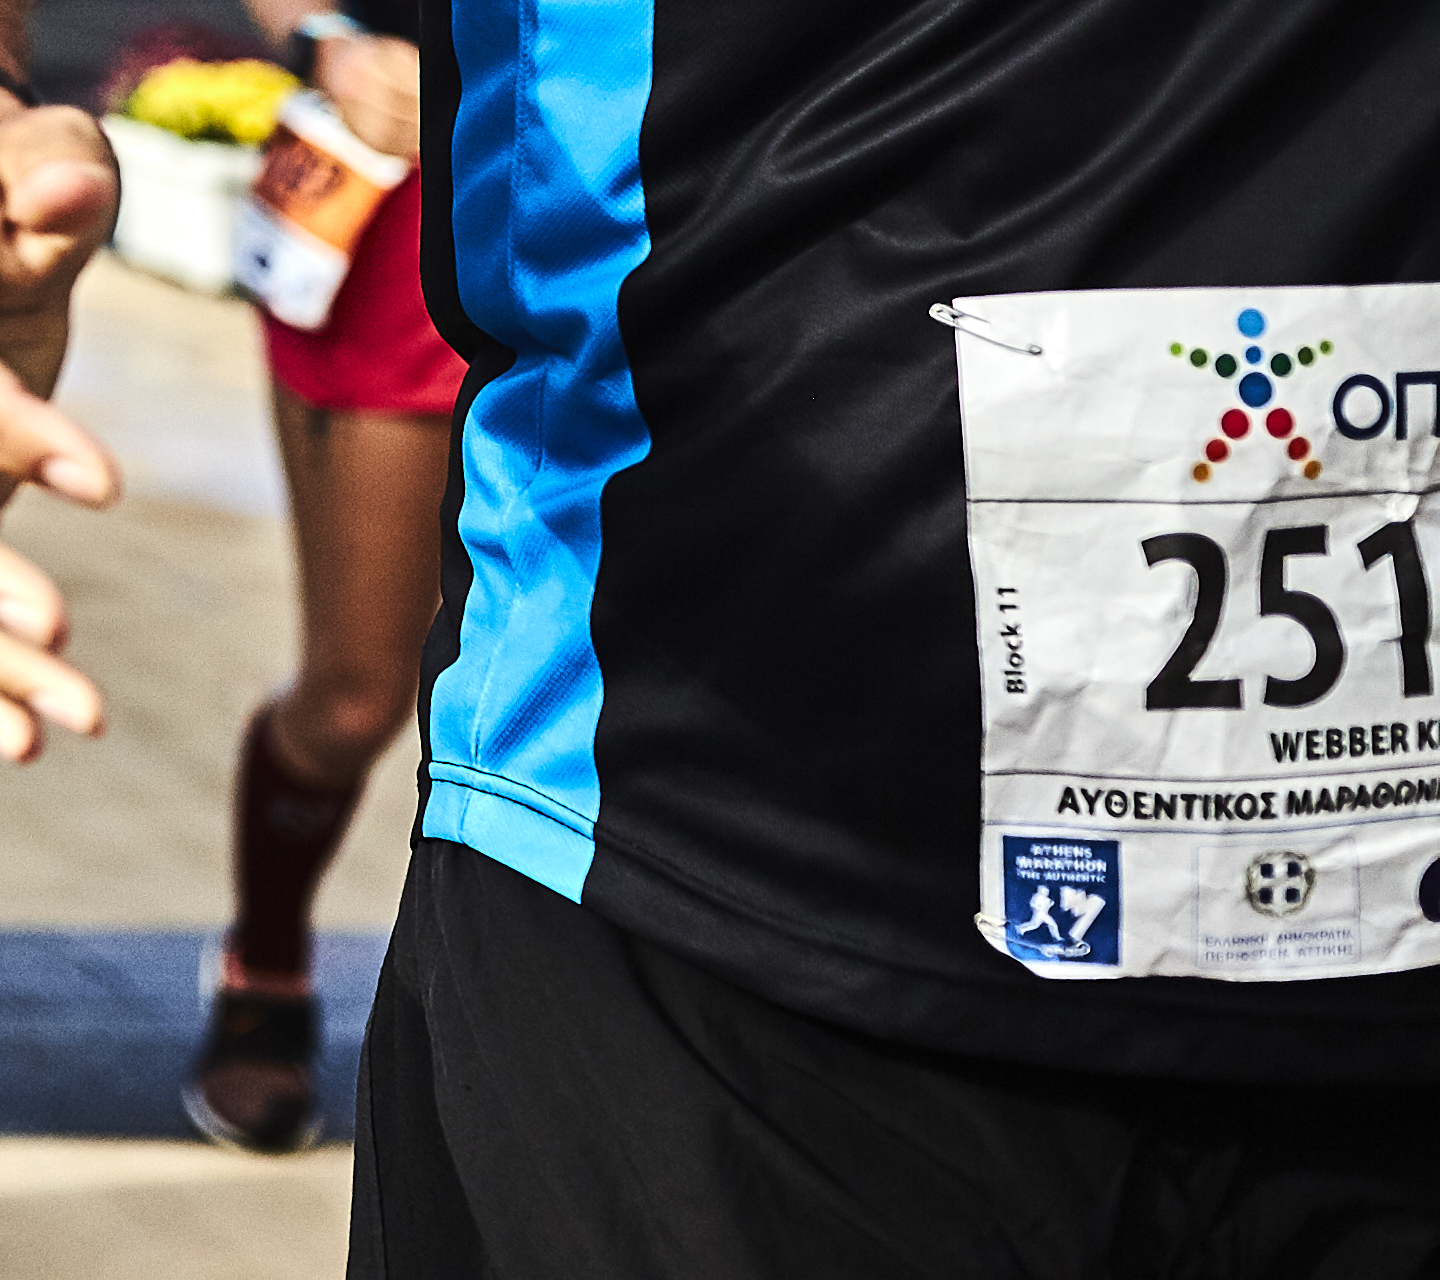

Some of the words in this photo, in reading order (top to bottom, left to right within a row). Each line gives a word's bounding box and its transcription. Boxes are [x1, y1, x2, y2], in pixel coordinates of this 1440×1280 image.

[998, 587, 1018, 613] 11
[1141, 520, 1434, 712] 251
[999, 624, 1025, 693] Block
[1270, 722, 1409, 763] WEBBER
[1418, 719, 1440, 751] K
[1058, 786, 1277, 821] ΑΥΘΕΝΤΙΚΟΣ
